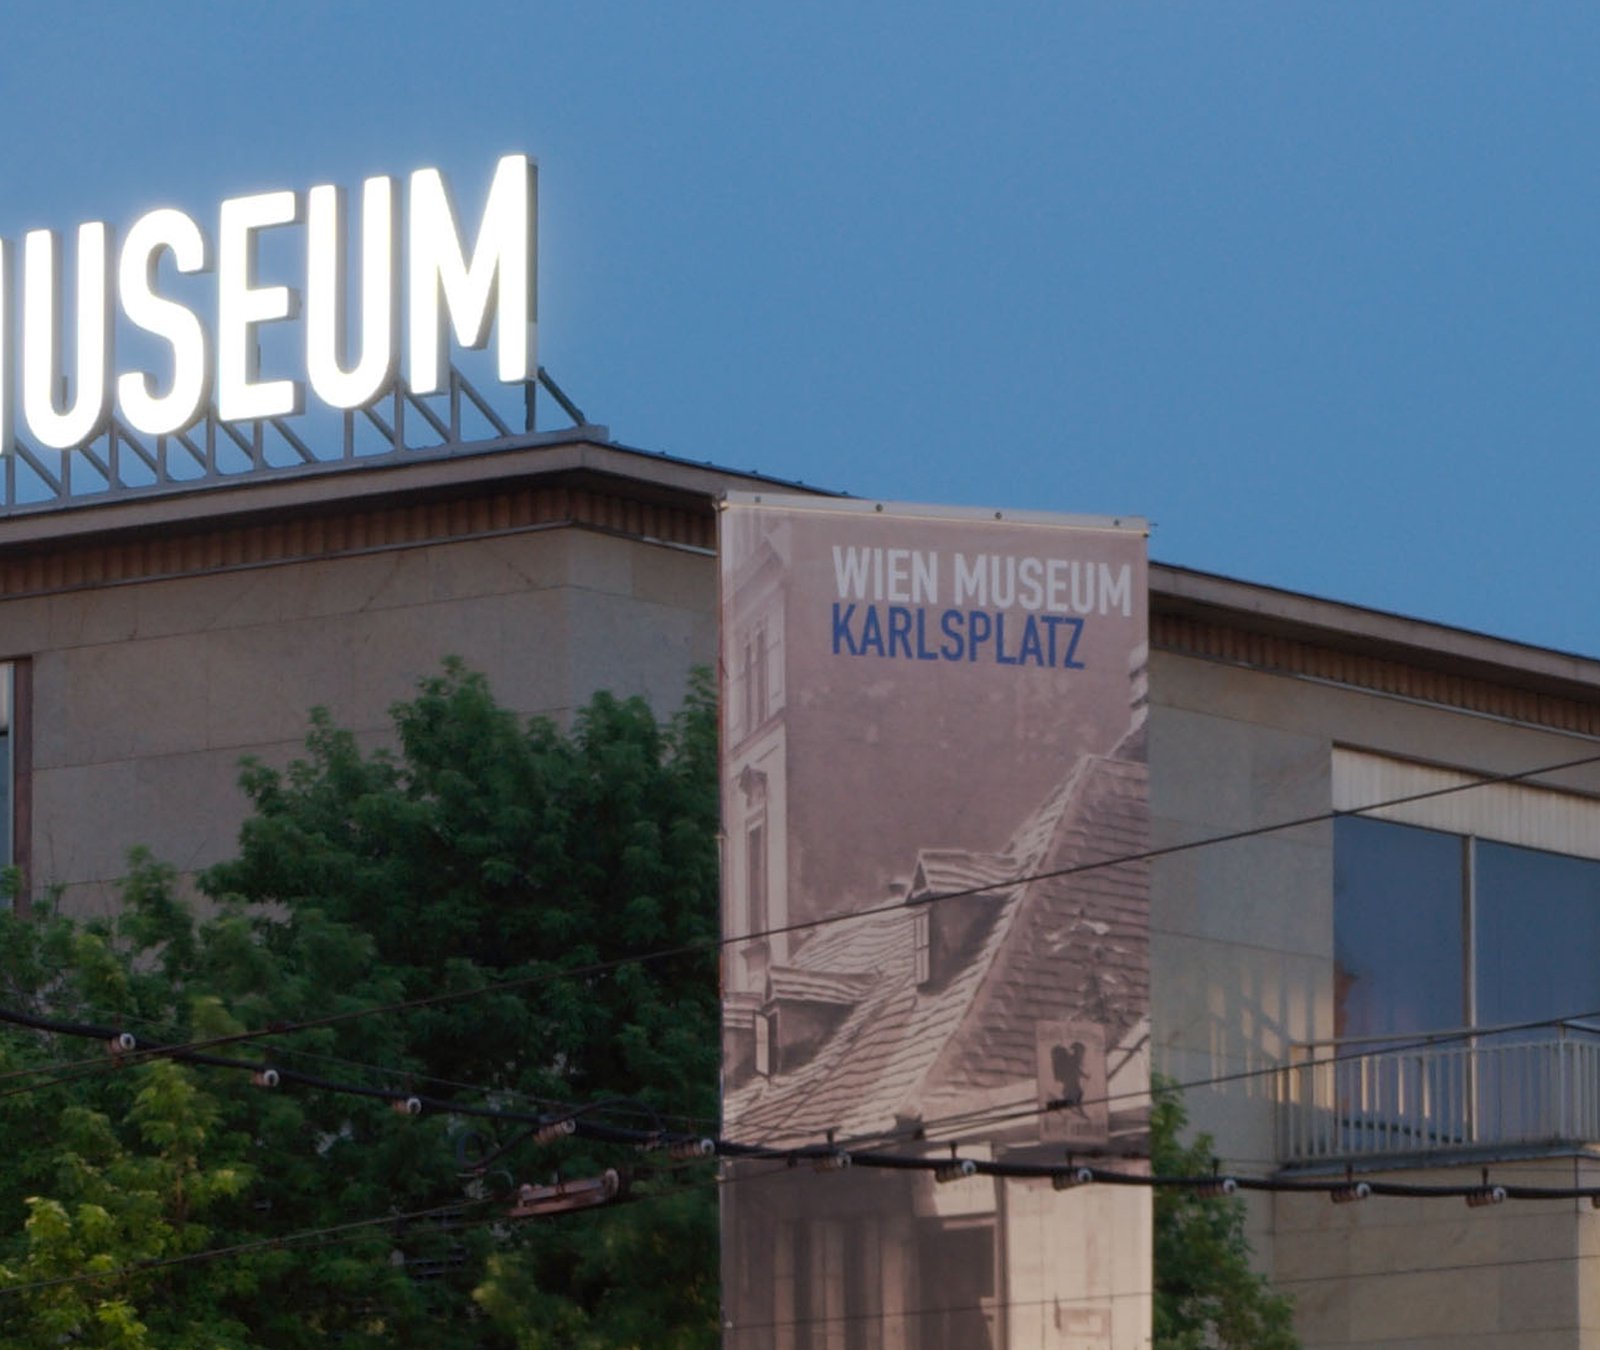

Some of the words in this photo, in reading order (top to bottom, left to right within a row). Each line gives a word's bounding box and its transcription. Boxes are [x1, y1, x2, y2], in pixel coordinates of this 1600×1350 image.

[832, 546, 938, 604] WIEN
[954, 552, 1132, 617] MUSEUM
[832, 602, 1085, 669] KARLSPLATZ
